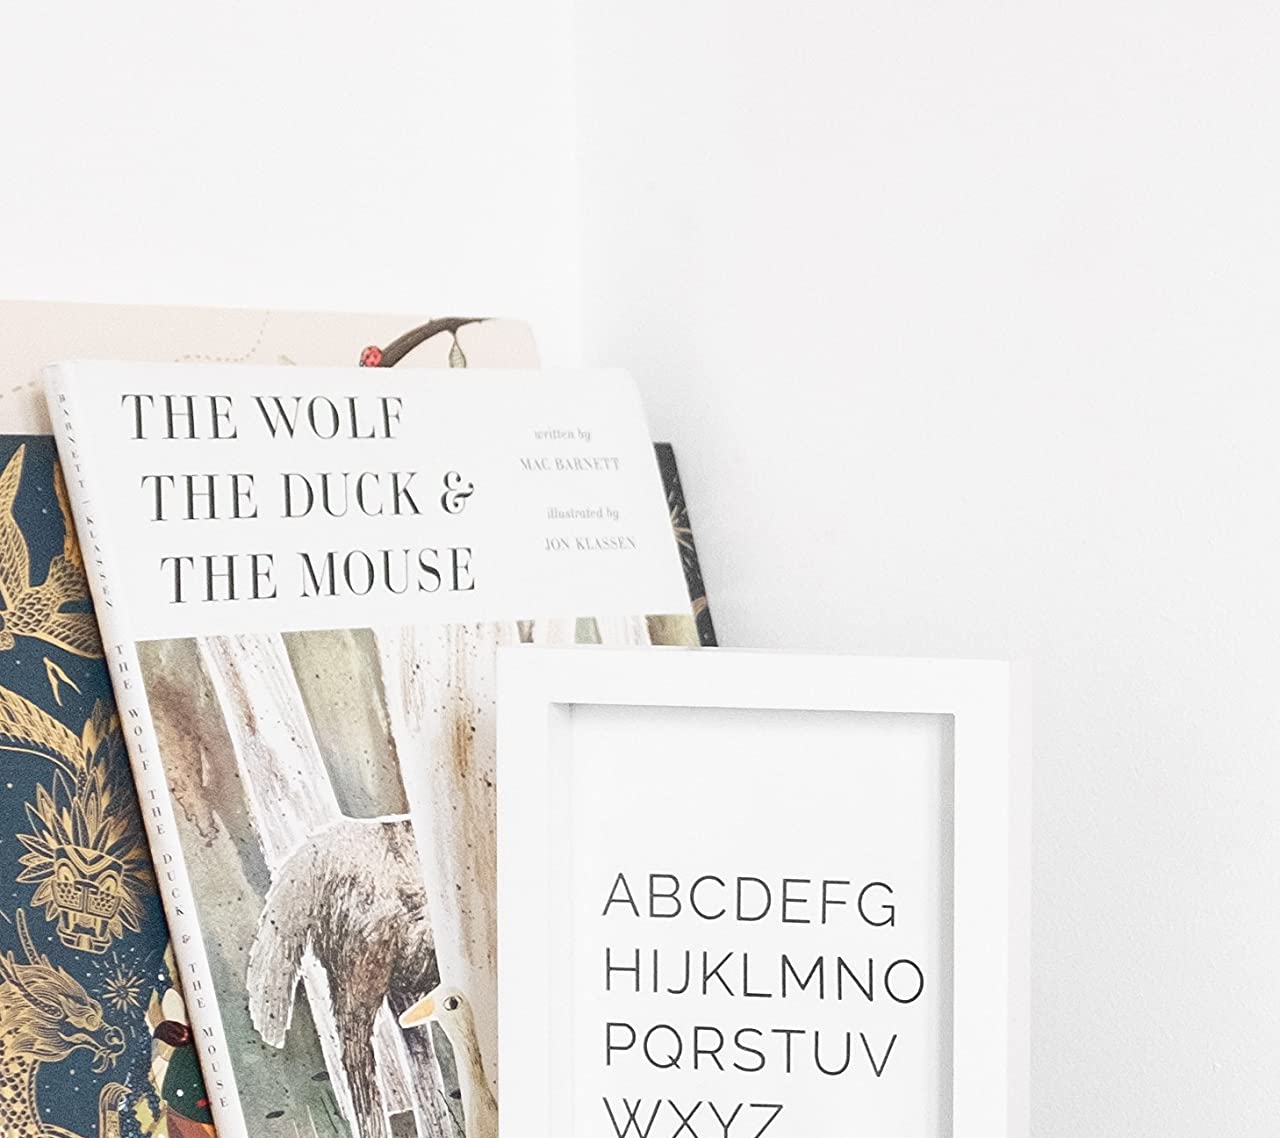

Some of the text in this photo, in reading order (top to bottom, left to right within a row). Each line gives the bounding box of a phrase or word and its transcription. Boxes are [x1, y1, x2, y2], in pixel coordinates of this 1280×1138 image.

[59, 394, 85, 488] BARNETT
[121, 394, 403, 440] THE WOLF
[534, 427, 591, 442] written by
[520, 457, 619, 471] MAC BARNETT
[141, 470, 475, 521] THE DUCK &
[546, 506, 619, 521] illustrated by
[544, 536, 637, 551] JON KLASSEN
[160, 547, 475, 604] THE MOUSE
[115, 644, 133, 690] THE
[128, 708, 151, 772] WOLF
[147, 789, 167, 836] THE
[163, 852, 185, 917] DUCK
[189, 963, 208, 1009] THE
[203, 1027, 229, 1109] MOUSE
[602, 872, 896, 927] ABCDEFG
[605, 947, 925, 1004] HIJKLMNO
[605, 1022, 898, 1077] PQRSTUV
